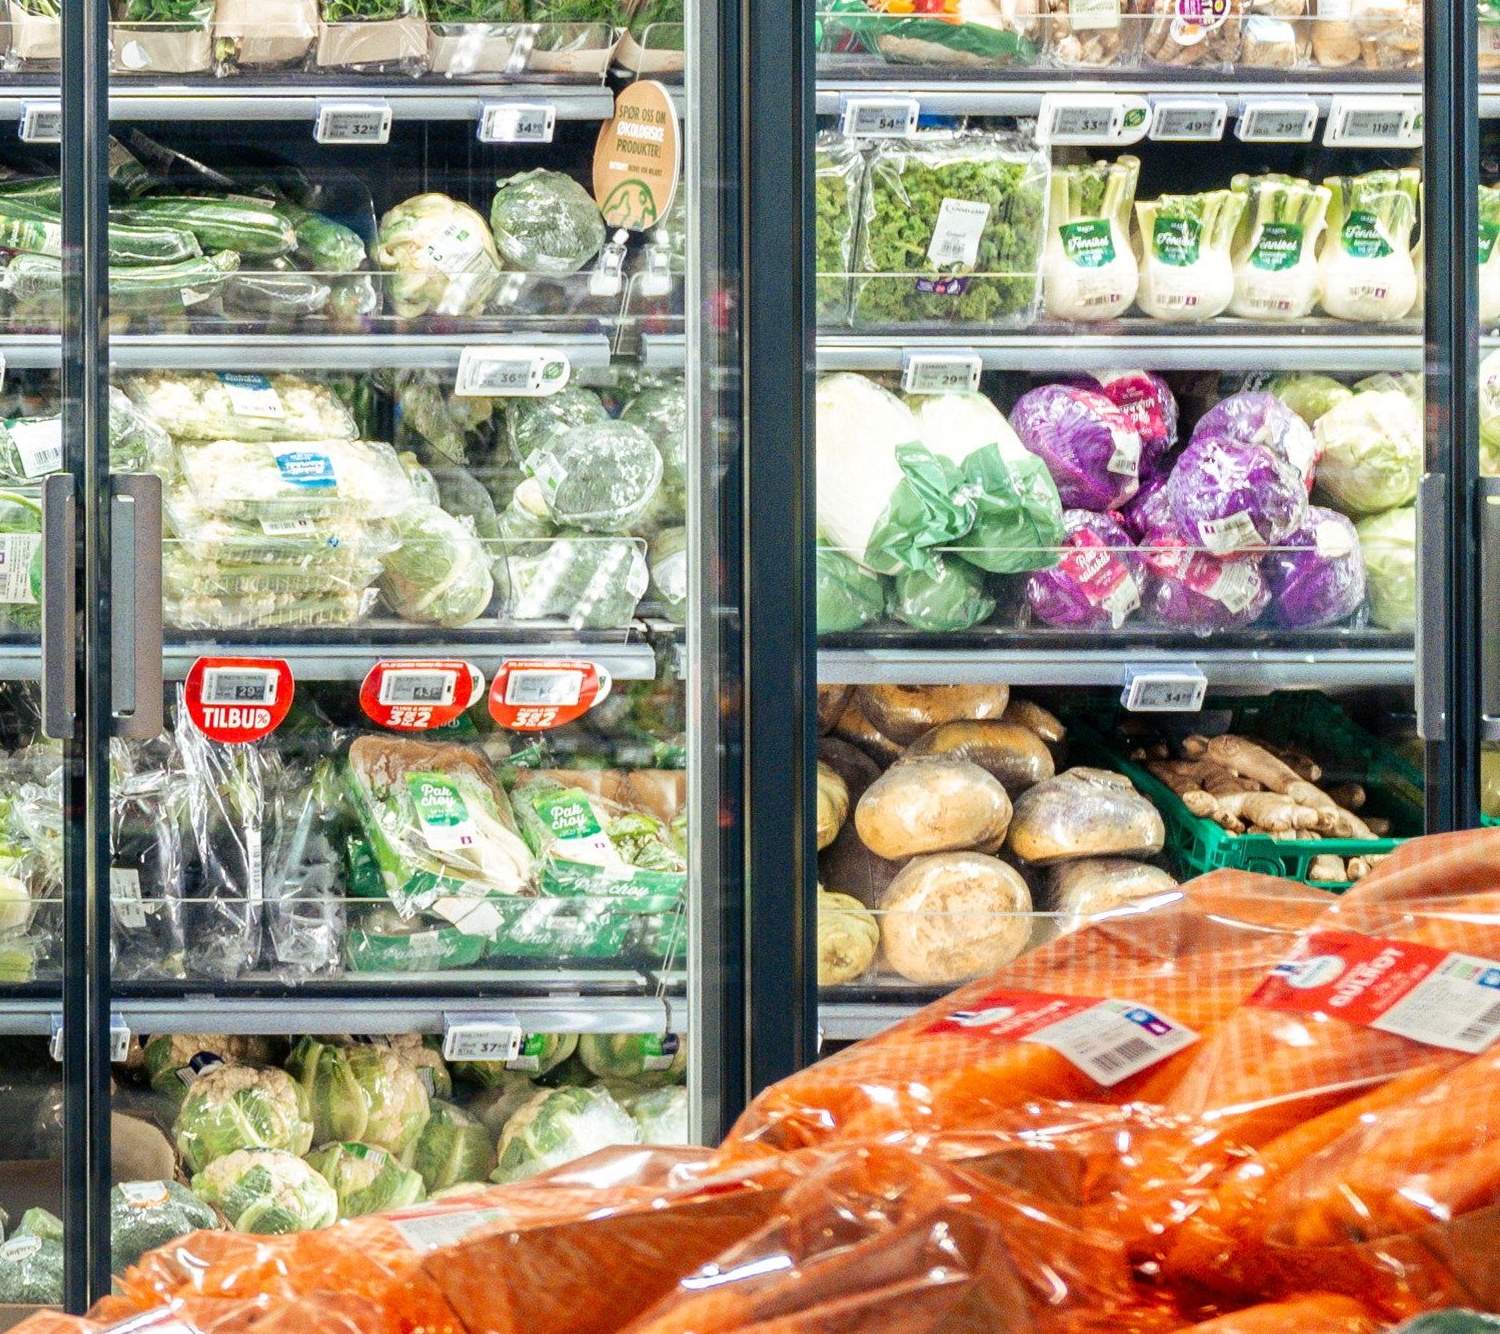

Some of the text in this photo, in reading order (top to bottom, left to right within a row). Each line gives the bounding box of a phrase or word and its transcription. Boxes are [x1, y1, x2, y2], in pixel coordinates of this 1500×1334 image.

[619, 104, 639, 119] SPØR
[640, 108, 654, 121] OSS
[616, 122, 665, 143] ØKOLOGISKE
[616, 139, 662, 159] PRODUKTER!
[420, 783, 453, 797] Pak
[420, 792, 457, 809] choy
[550, 802, 584, 819] Pak
[551, 814, 588, 831] choy
